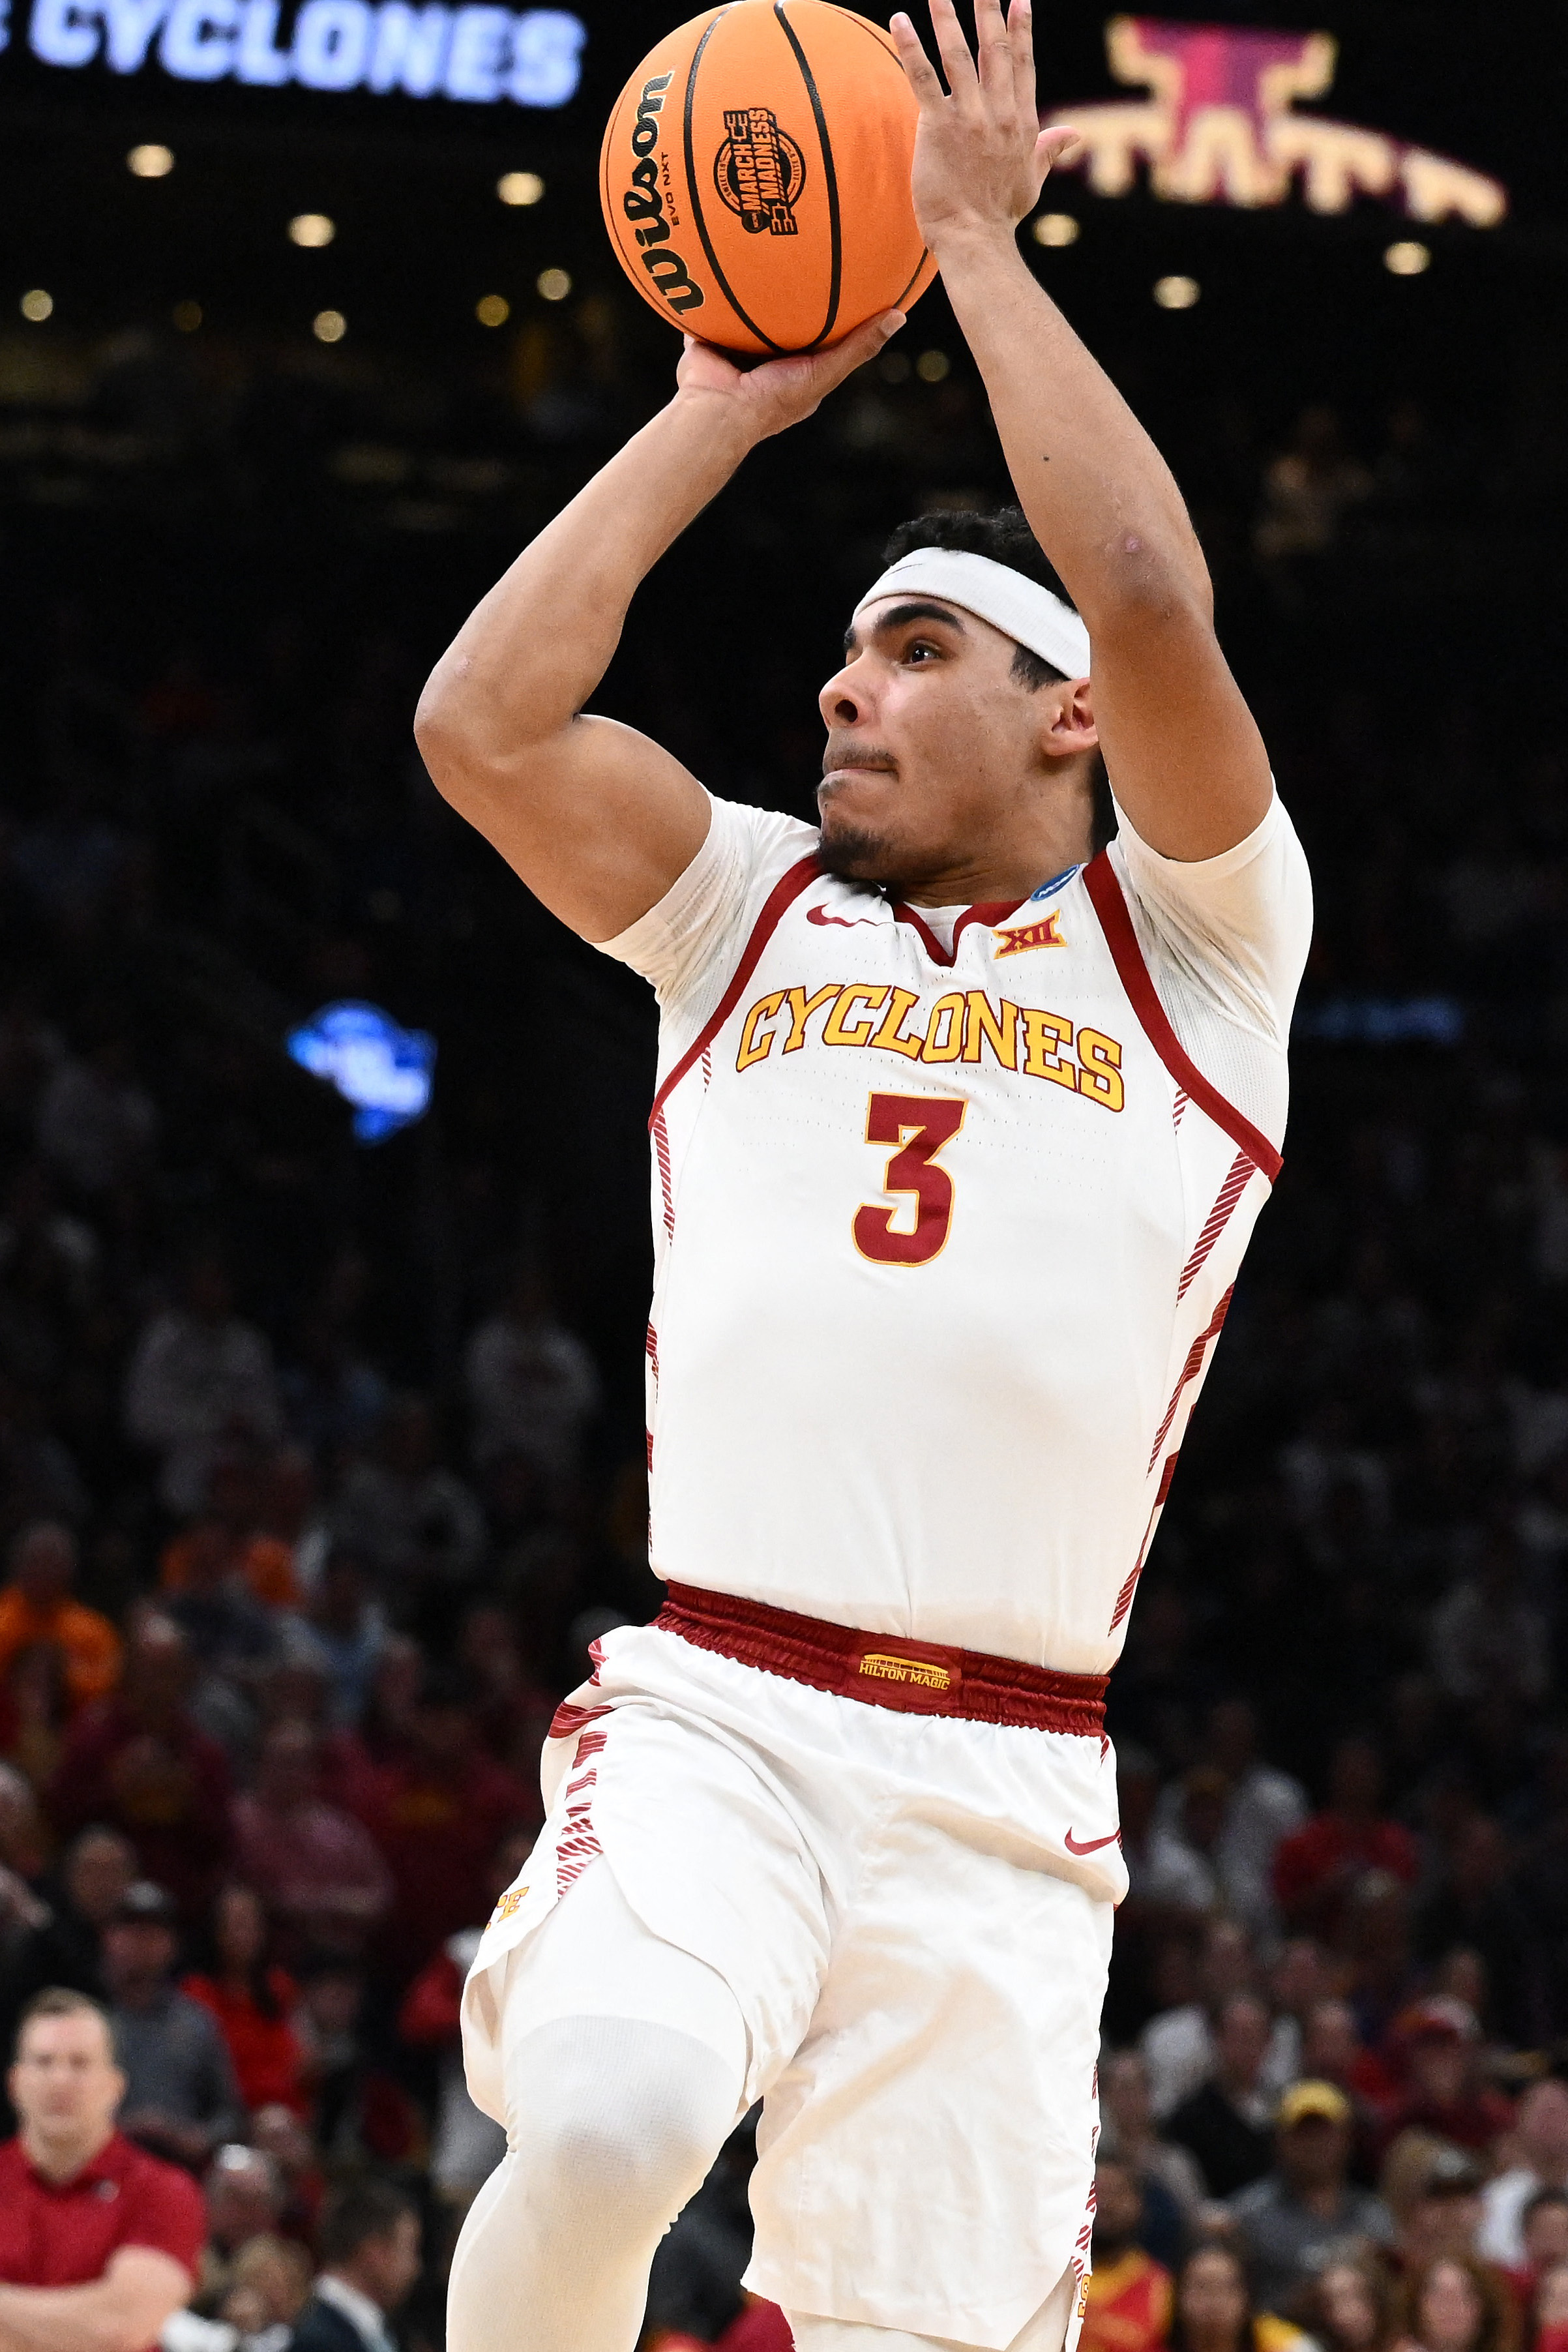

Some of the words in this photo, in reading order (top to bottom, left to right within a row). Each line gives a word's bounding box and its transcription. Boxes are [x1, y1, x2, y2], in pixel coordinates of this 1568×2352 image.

[29, 0, 587, 109] CYCLONES
[623, 70, 705, 316] Wilson
[660, 152, 670, 186] NXT
[732, 143, 762, 211] MARCH
[748, 108, 781, 200] MADNESS
[664, 192, 679, 226] EVO
[736, 983, 1125, 1112] CYCLONES
[851, 1090, 969, 1267] 3
[859, 1663, 907, 1681] HILTON
[910, 1673, 951, 1690] MAGIC
